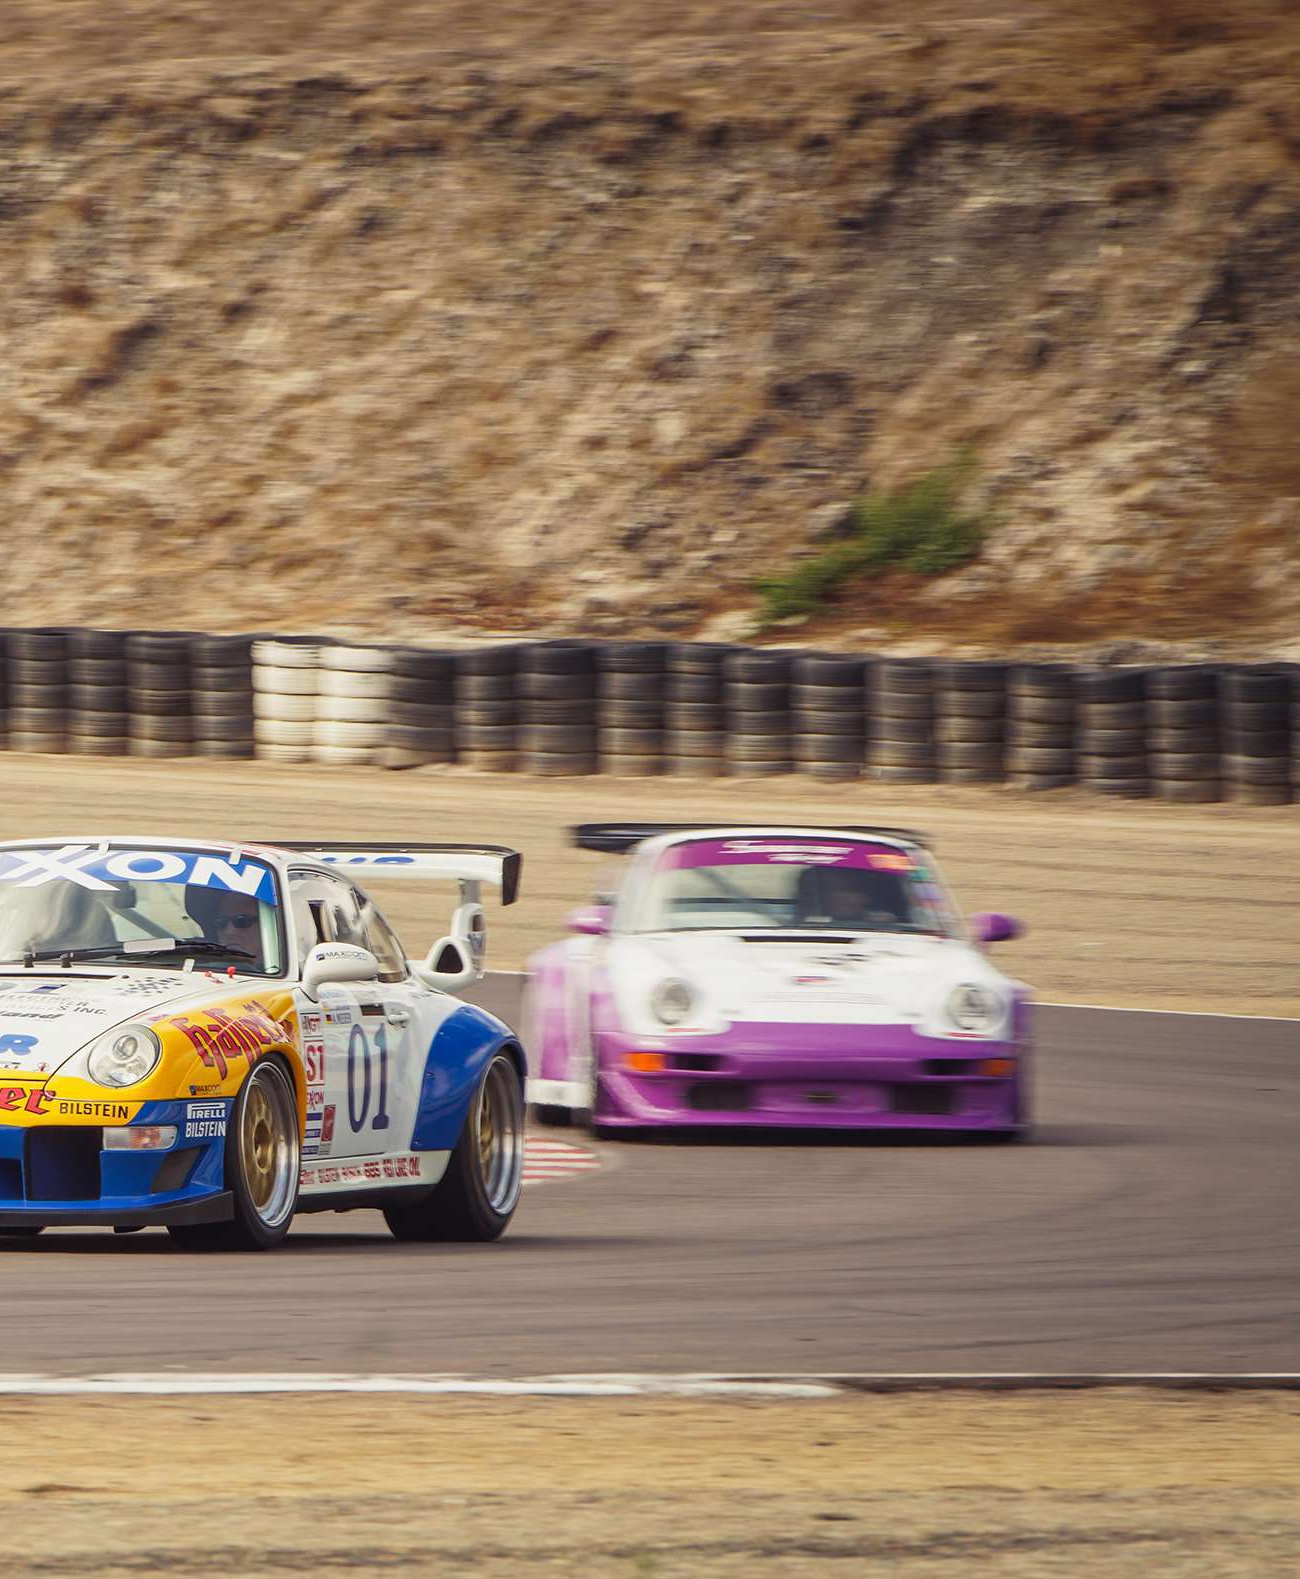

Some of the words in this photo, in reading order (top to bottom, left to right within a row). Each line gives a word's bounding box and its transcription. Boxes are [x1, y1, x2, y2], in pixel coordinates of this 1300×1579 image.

[346, 1023, 390, 1133] 01
[59, 1102, 129, 1119] BILSTEIN
[187, 1102, 226, 1119] PIRELLI
[185, 1121, 226, 1138] BILSTEIN
